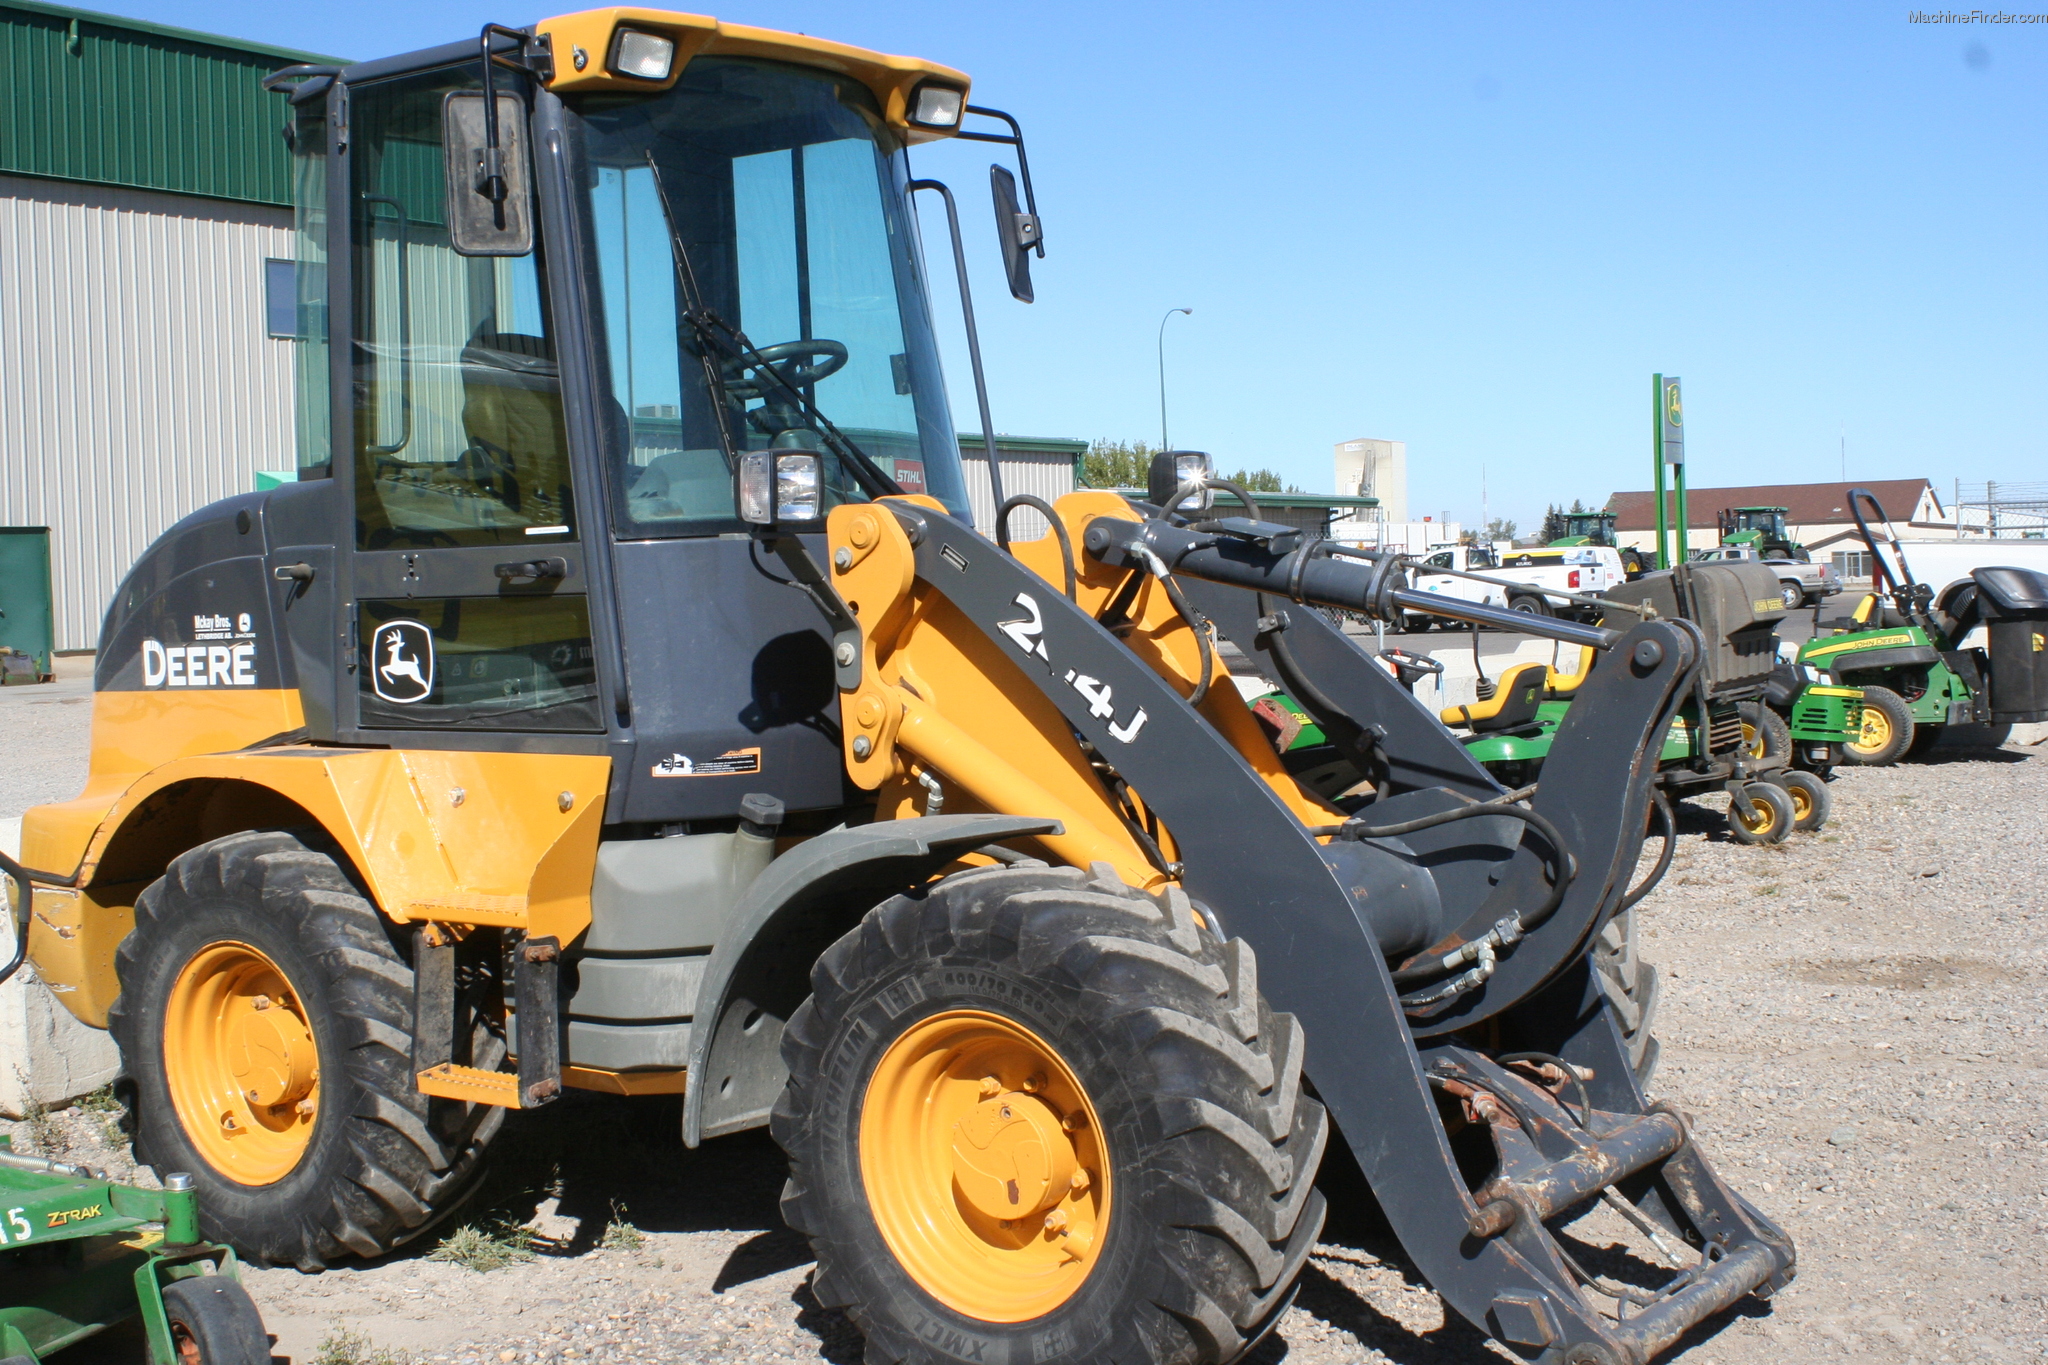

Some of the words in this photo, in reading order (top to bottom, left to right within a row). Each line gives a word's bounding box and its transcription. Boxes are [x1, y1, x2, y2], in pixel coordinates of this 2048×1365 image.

[896, 469, 922, 484] STIHL
[1853, 639, 1875, 649] JOHN
[1876, 637, 1904, 645] DEERE
[143, 640, 256, 686] DEERE
[1291, 712, 1308, 720] DEE
[944, 972, 1007, 993] 400/70
[1011, 986, 1044, 1013] R20
[822, 1020, 869, 1162] MICHELIN
[47, 1204, 102, 1228] ZTRAK
